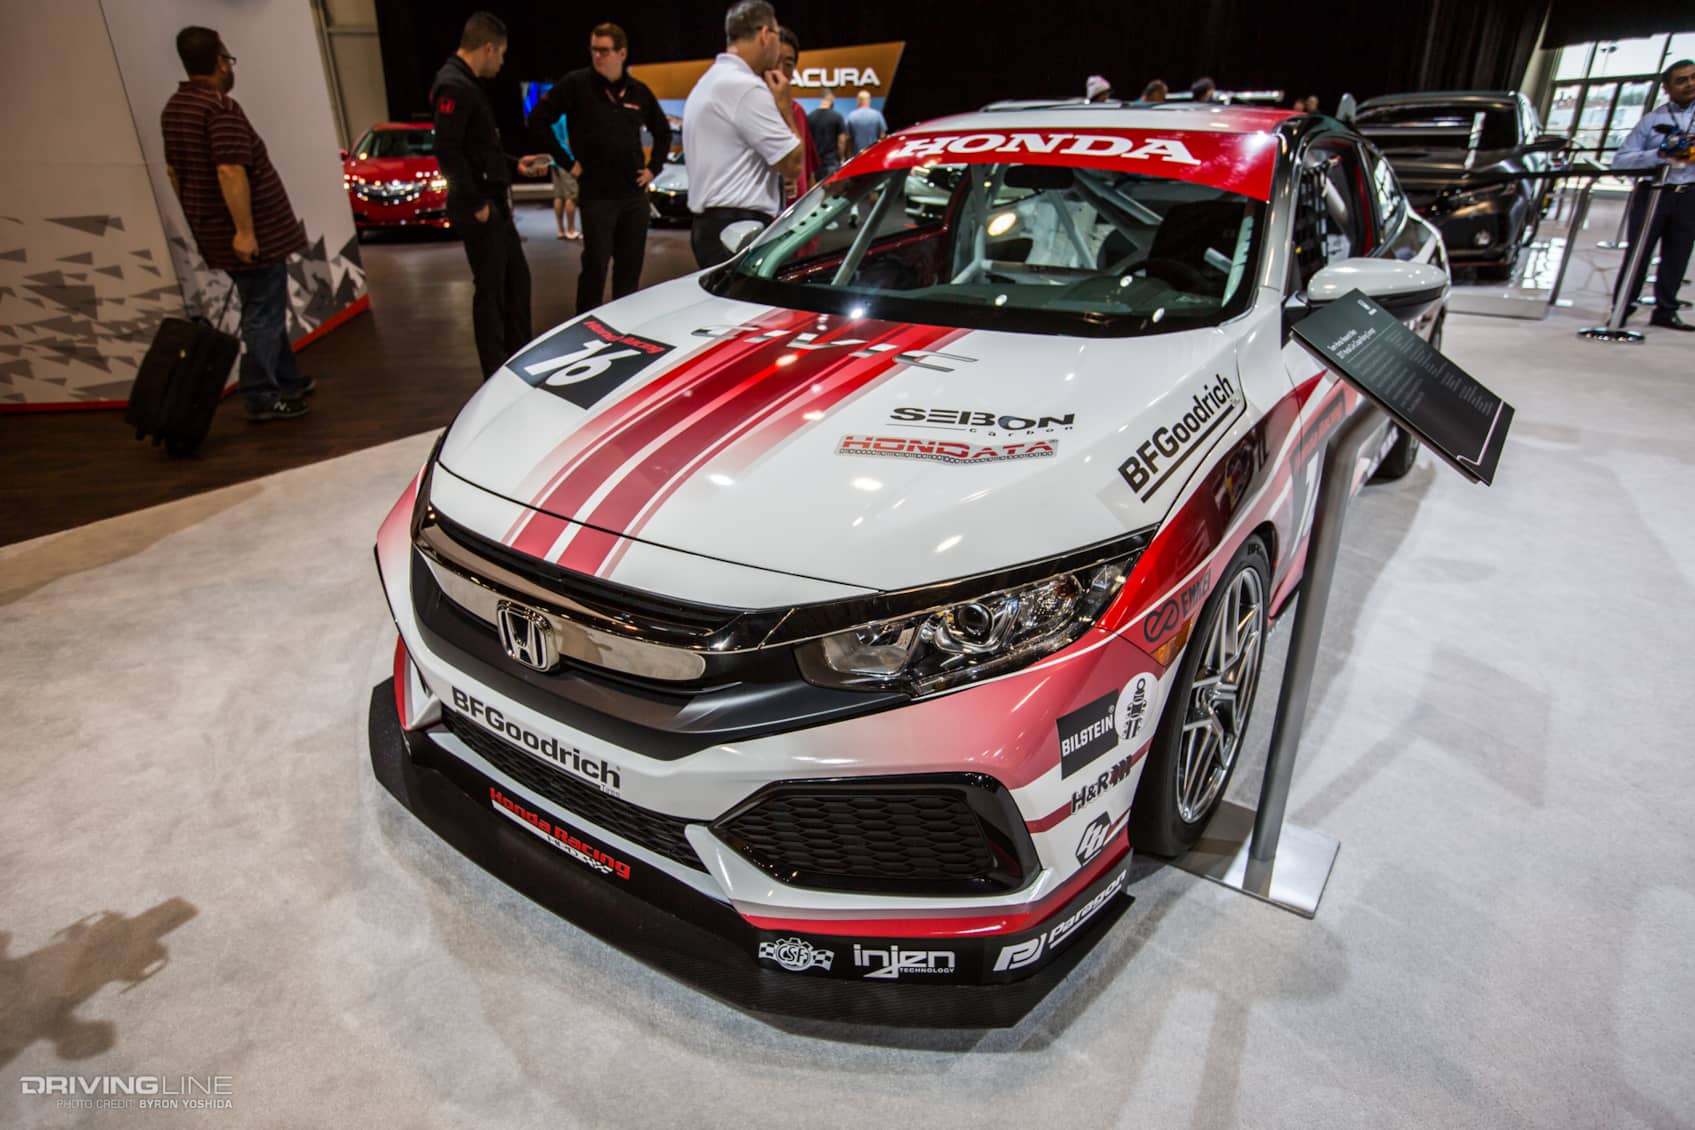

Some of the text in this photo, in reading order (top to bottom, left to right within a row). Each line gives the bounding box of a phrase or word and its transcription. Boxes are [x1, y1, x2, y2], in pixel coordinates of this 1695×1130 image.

[790, 67, 880, 87] ACURA
[897, 133, 1202, 165] HONDA
[523, 340, 642, 386] 16
[889, 407, 1075, 431] SEBON
[1118, 373, 1234, 494] BFGoodrich
[841, 436, 1054, 459] HONDATA
[452, 686, 620, 789] BFGoodrich
[1062, 714, 1114, 757] BILSTEIN
[1071, 771, 1110, 813] H&R
[489, 787, 551, 834] Honda
[553, 825, 631, 880] Racing
